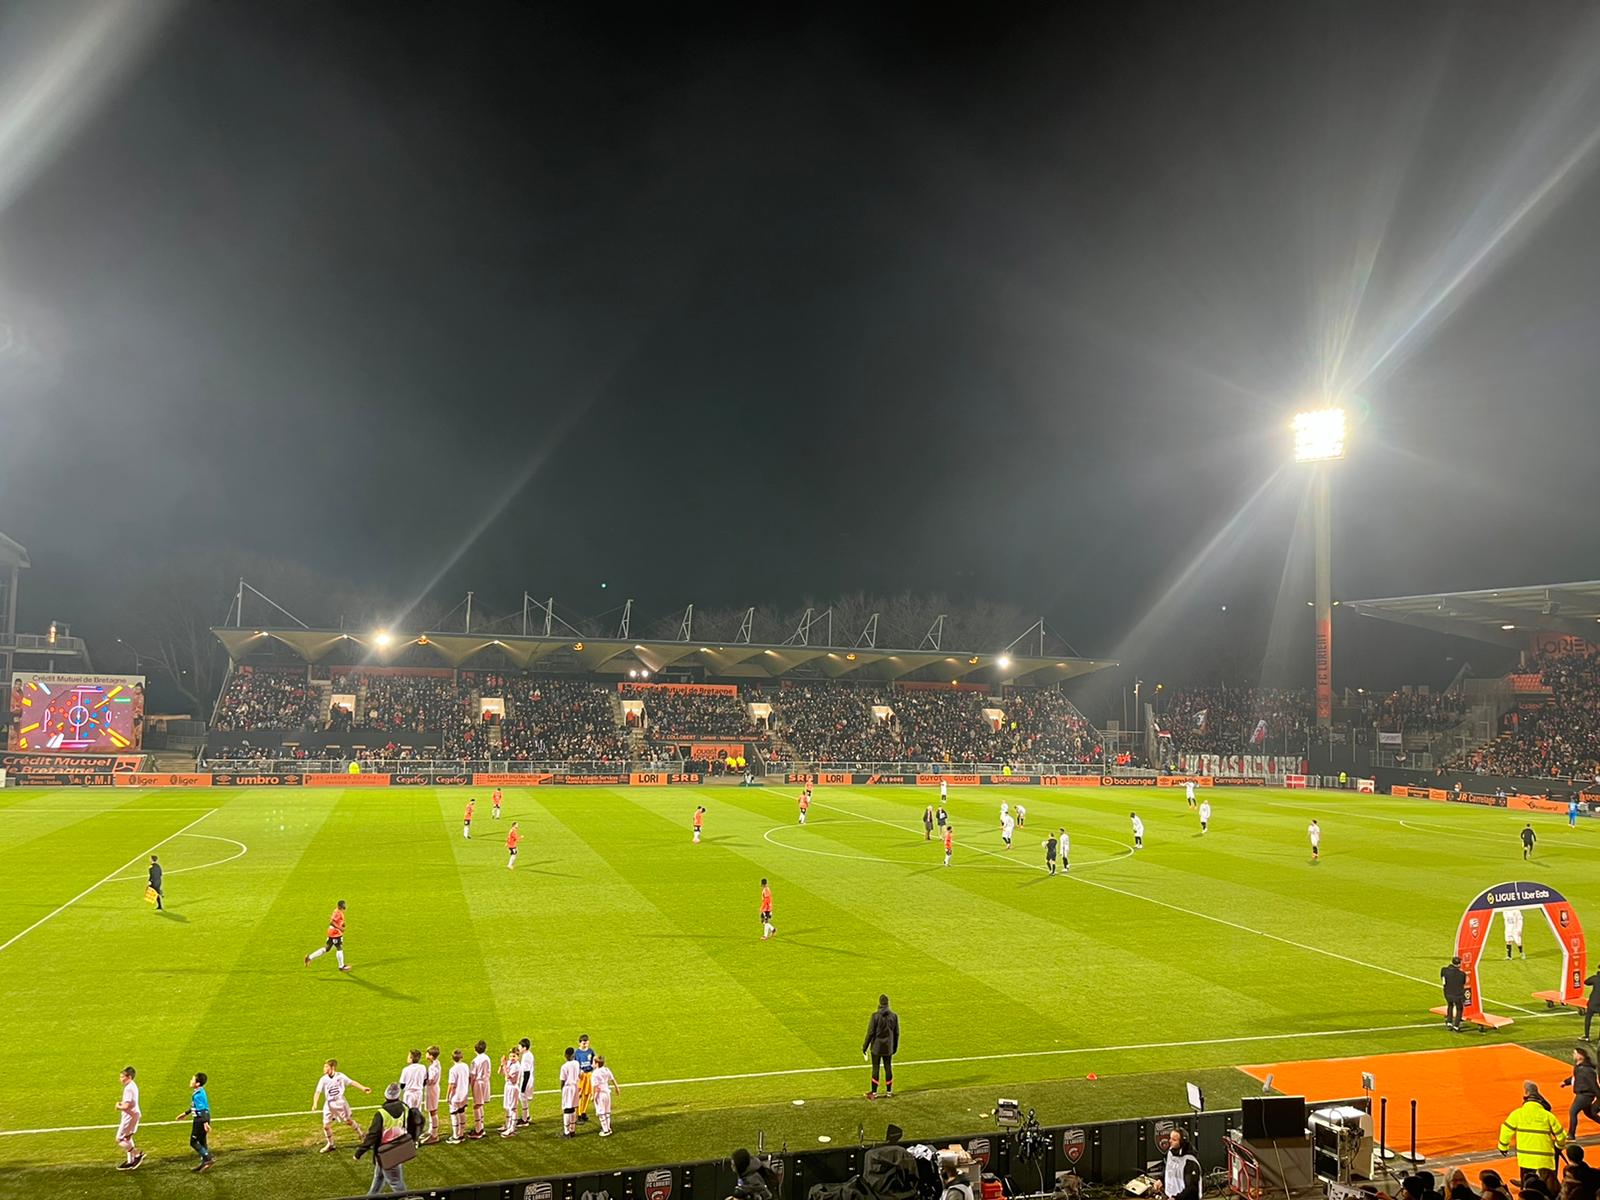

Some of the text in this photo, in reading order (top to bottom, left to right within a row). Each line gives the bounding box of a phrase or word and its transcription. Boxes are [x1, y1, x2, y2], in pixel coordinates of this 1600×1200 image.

[57, 675, 82, 683] Mutuel
[94, 676, 127, 684] Bretagne
[3, 756, 112, 767] Crédit Mutuel
[236, 774, 280, 785] umbro
[638, 774, 659, 783] LORI
[671, 774, 699, 782] SRB
[826, 774, 844, 783] LORI
[1113, 777, 1156, 786] boulanger
[1495, 892, 1516, 903] LIGUE
[1521, 891, 1536, 900] Uber
[1536, 889, 1550, 899] Eats
